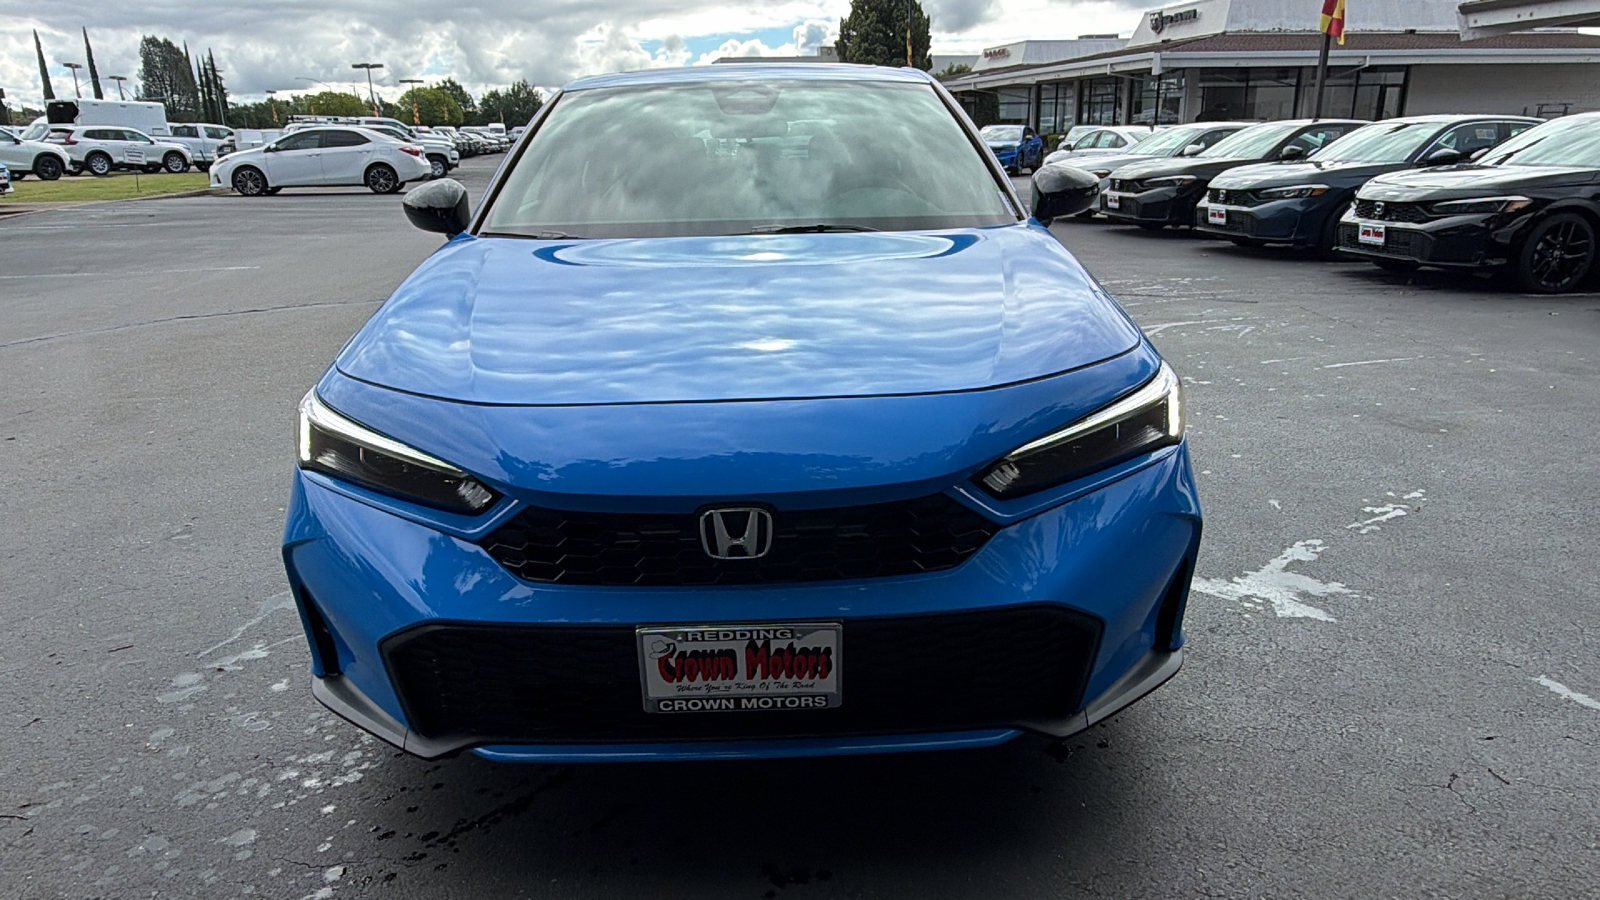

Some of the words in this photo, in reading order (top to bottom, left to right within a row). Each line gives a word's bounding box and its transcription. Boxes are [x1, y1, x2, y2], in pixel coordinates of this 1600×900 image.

[687, 629, 792, 641] REDDING
[658, 642, 738, 683] Crown
[745, 639, 833, 680] Motors
[676, 684, 702, 692] Where
[735, 682, 756, 691] King
[759, 681, 771, 691] Of
[773, 681, 789, 689] The
[792, 681, 816, 689] Road
[659, 699, 735, 711] CROWN
[741, 696, 827, 709] MOTORS
